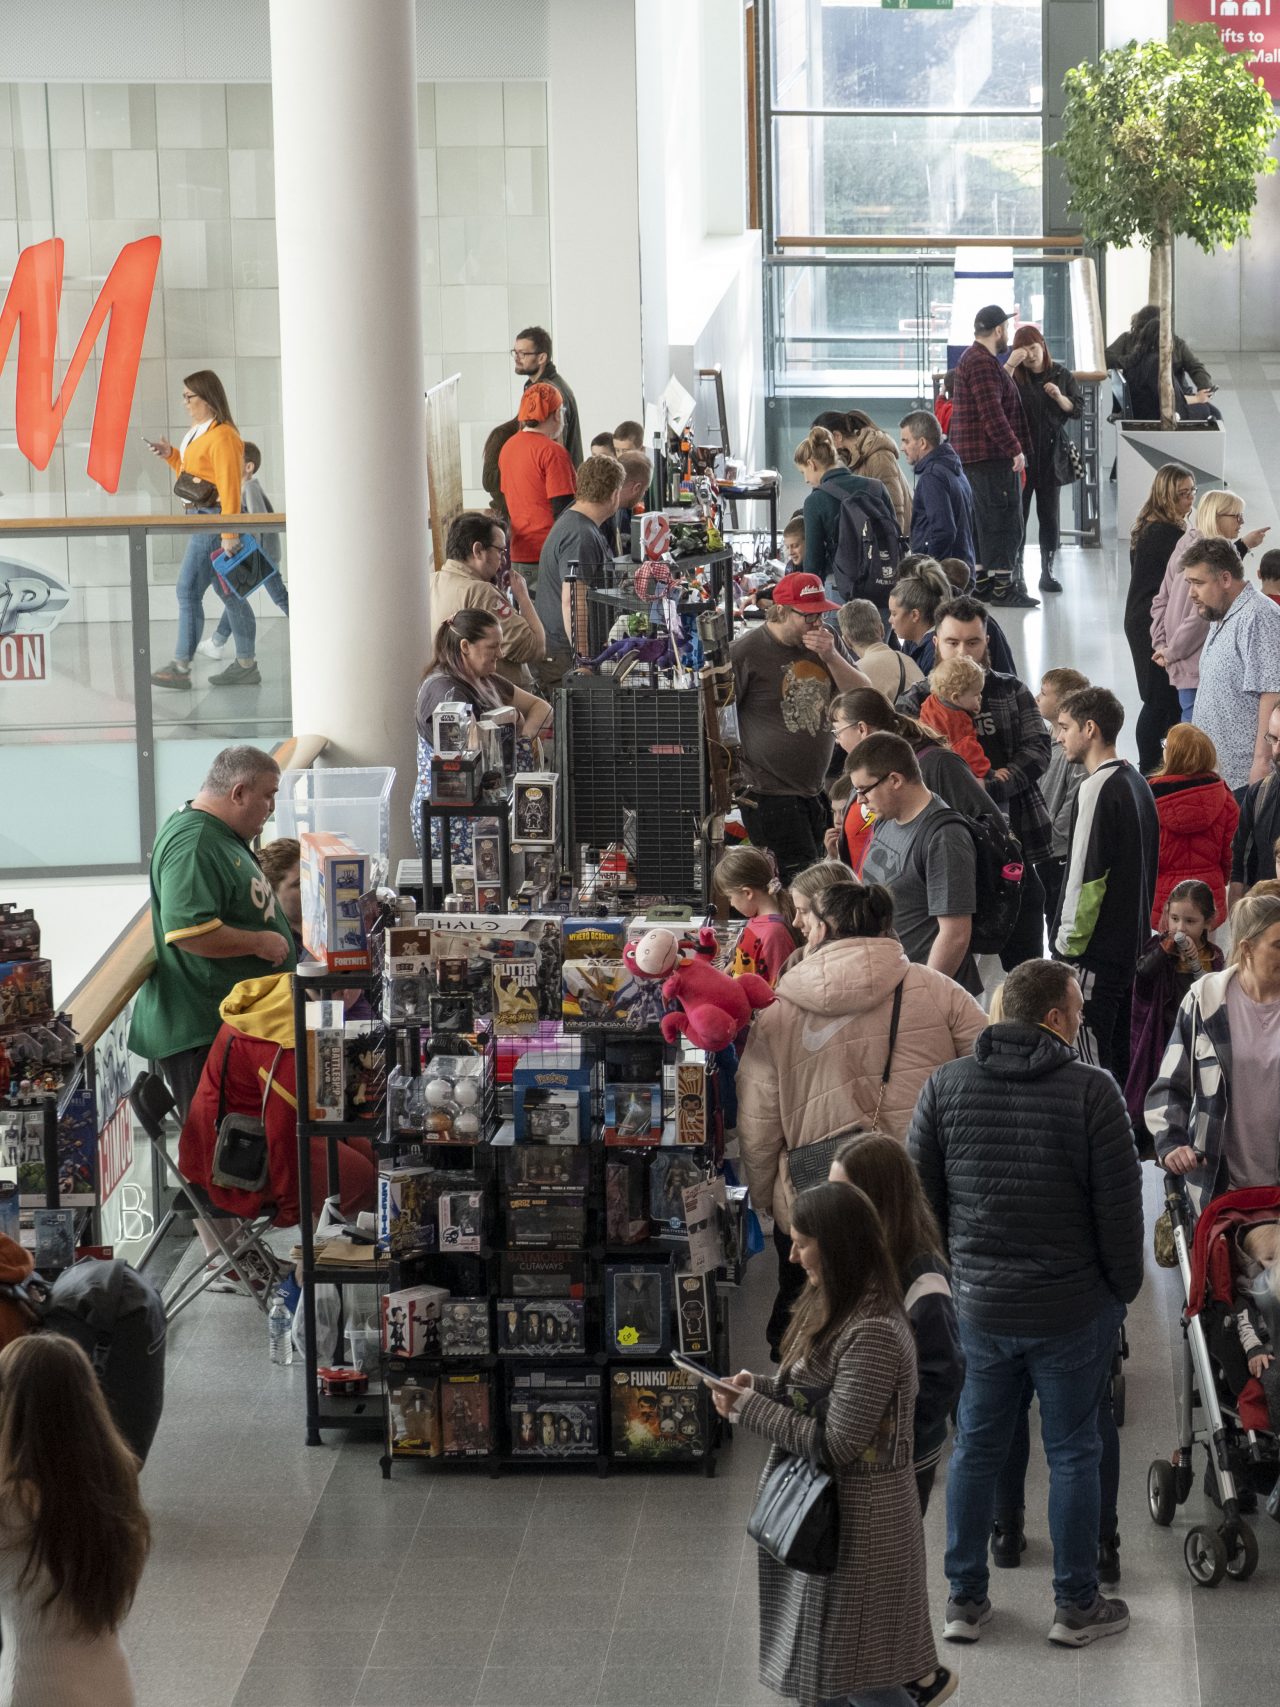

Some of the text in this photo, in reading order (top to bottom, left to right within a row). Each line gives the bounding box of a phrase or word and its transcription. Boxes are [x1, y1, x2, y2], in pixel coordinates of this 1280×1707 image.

[1220, 28, 1264, 43] ifts to
[1252, 48, 1280, 63] Mall
[437, 920, 500, 931] HALO
[334, 956, 367, 967] FORTNITE
[587, 1021, 625, 1029] GUNDAM
[331, 1047, 342, 1096] BATTLESHIP
